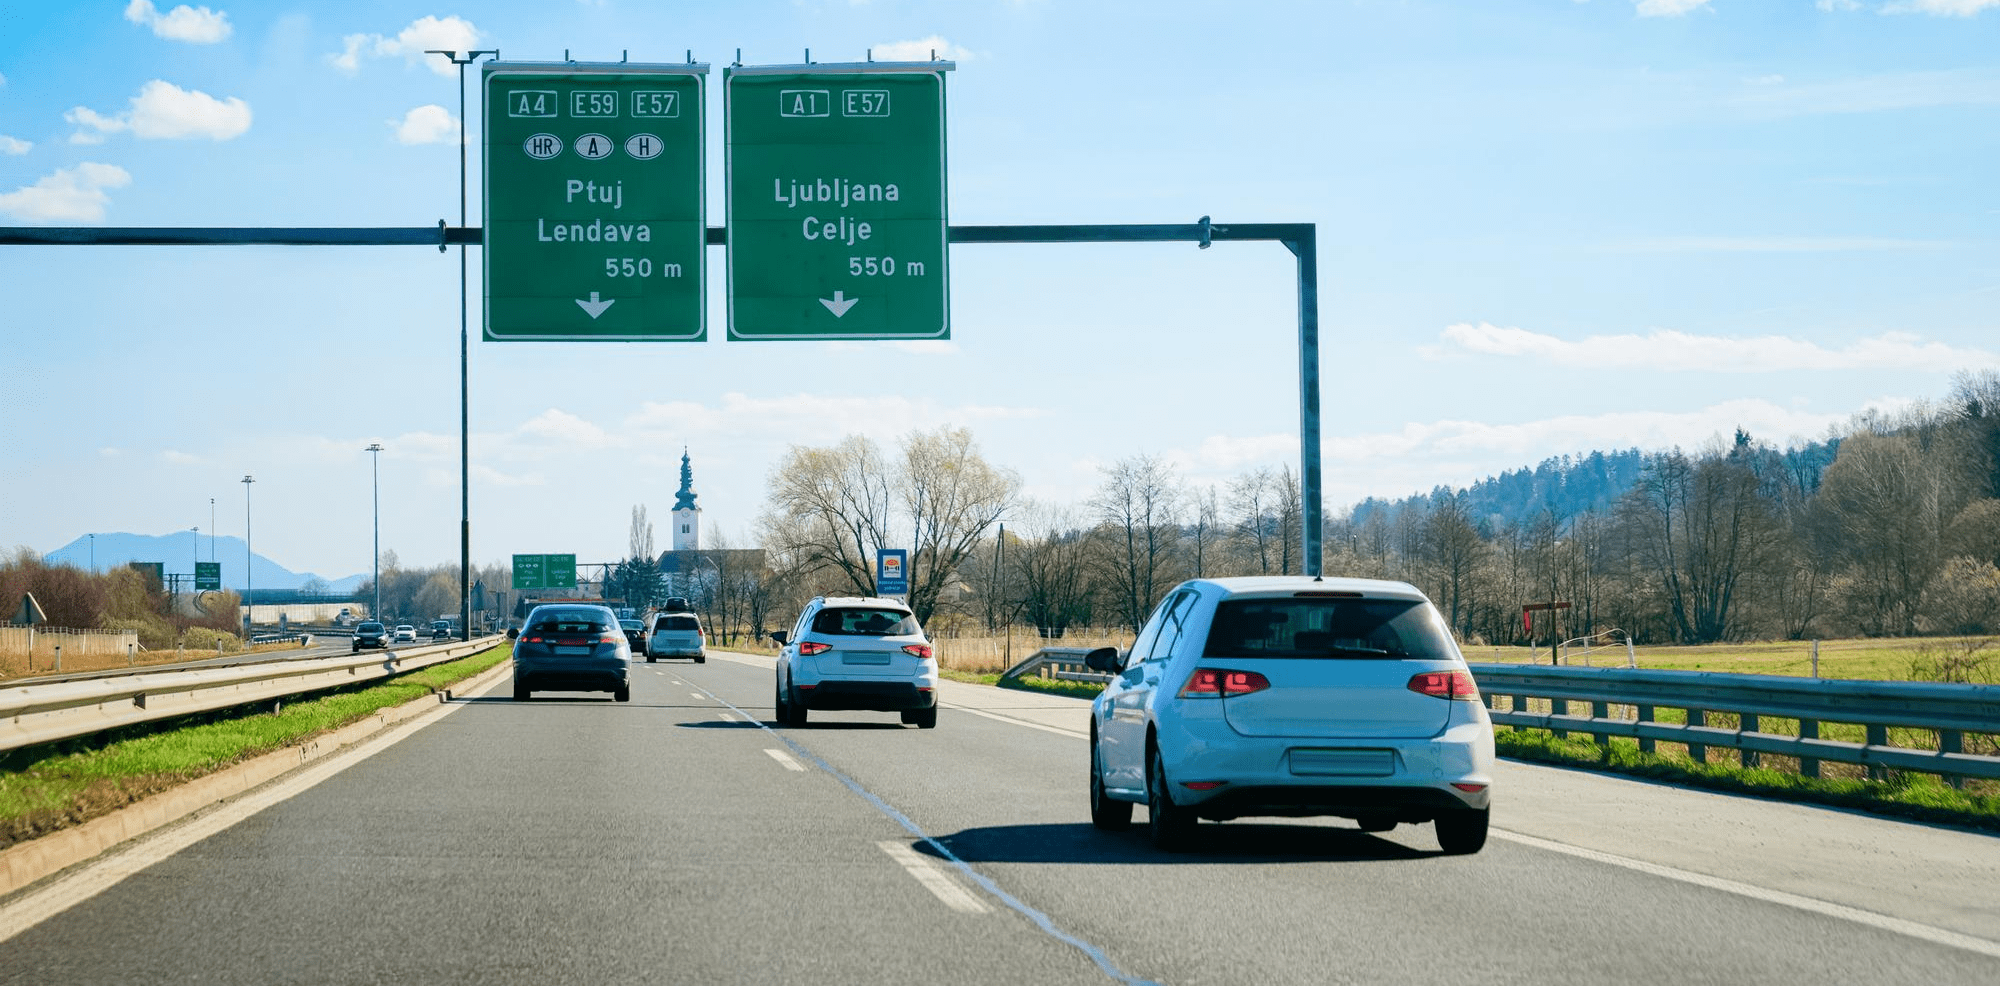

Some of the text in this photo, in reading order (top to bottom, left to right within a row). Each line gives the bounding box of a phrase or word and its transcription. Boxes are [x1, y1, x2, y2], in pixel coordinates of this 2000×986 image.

[520, 95, 674, 114] A4 E59 E57
[794, 94, 885, 114] A1 E57
[532, 138, 650, 156] HR A H
[567, 180, 622, 208] Ptuj
[775, 179, 899, 207] Ljubljana
[538, 219, 650, 242] Lendava
[803, 217, 872, 245] Celje
[606, 258, 682, 278] 550 m
[849, 256, 925, 276] 550 m
